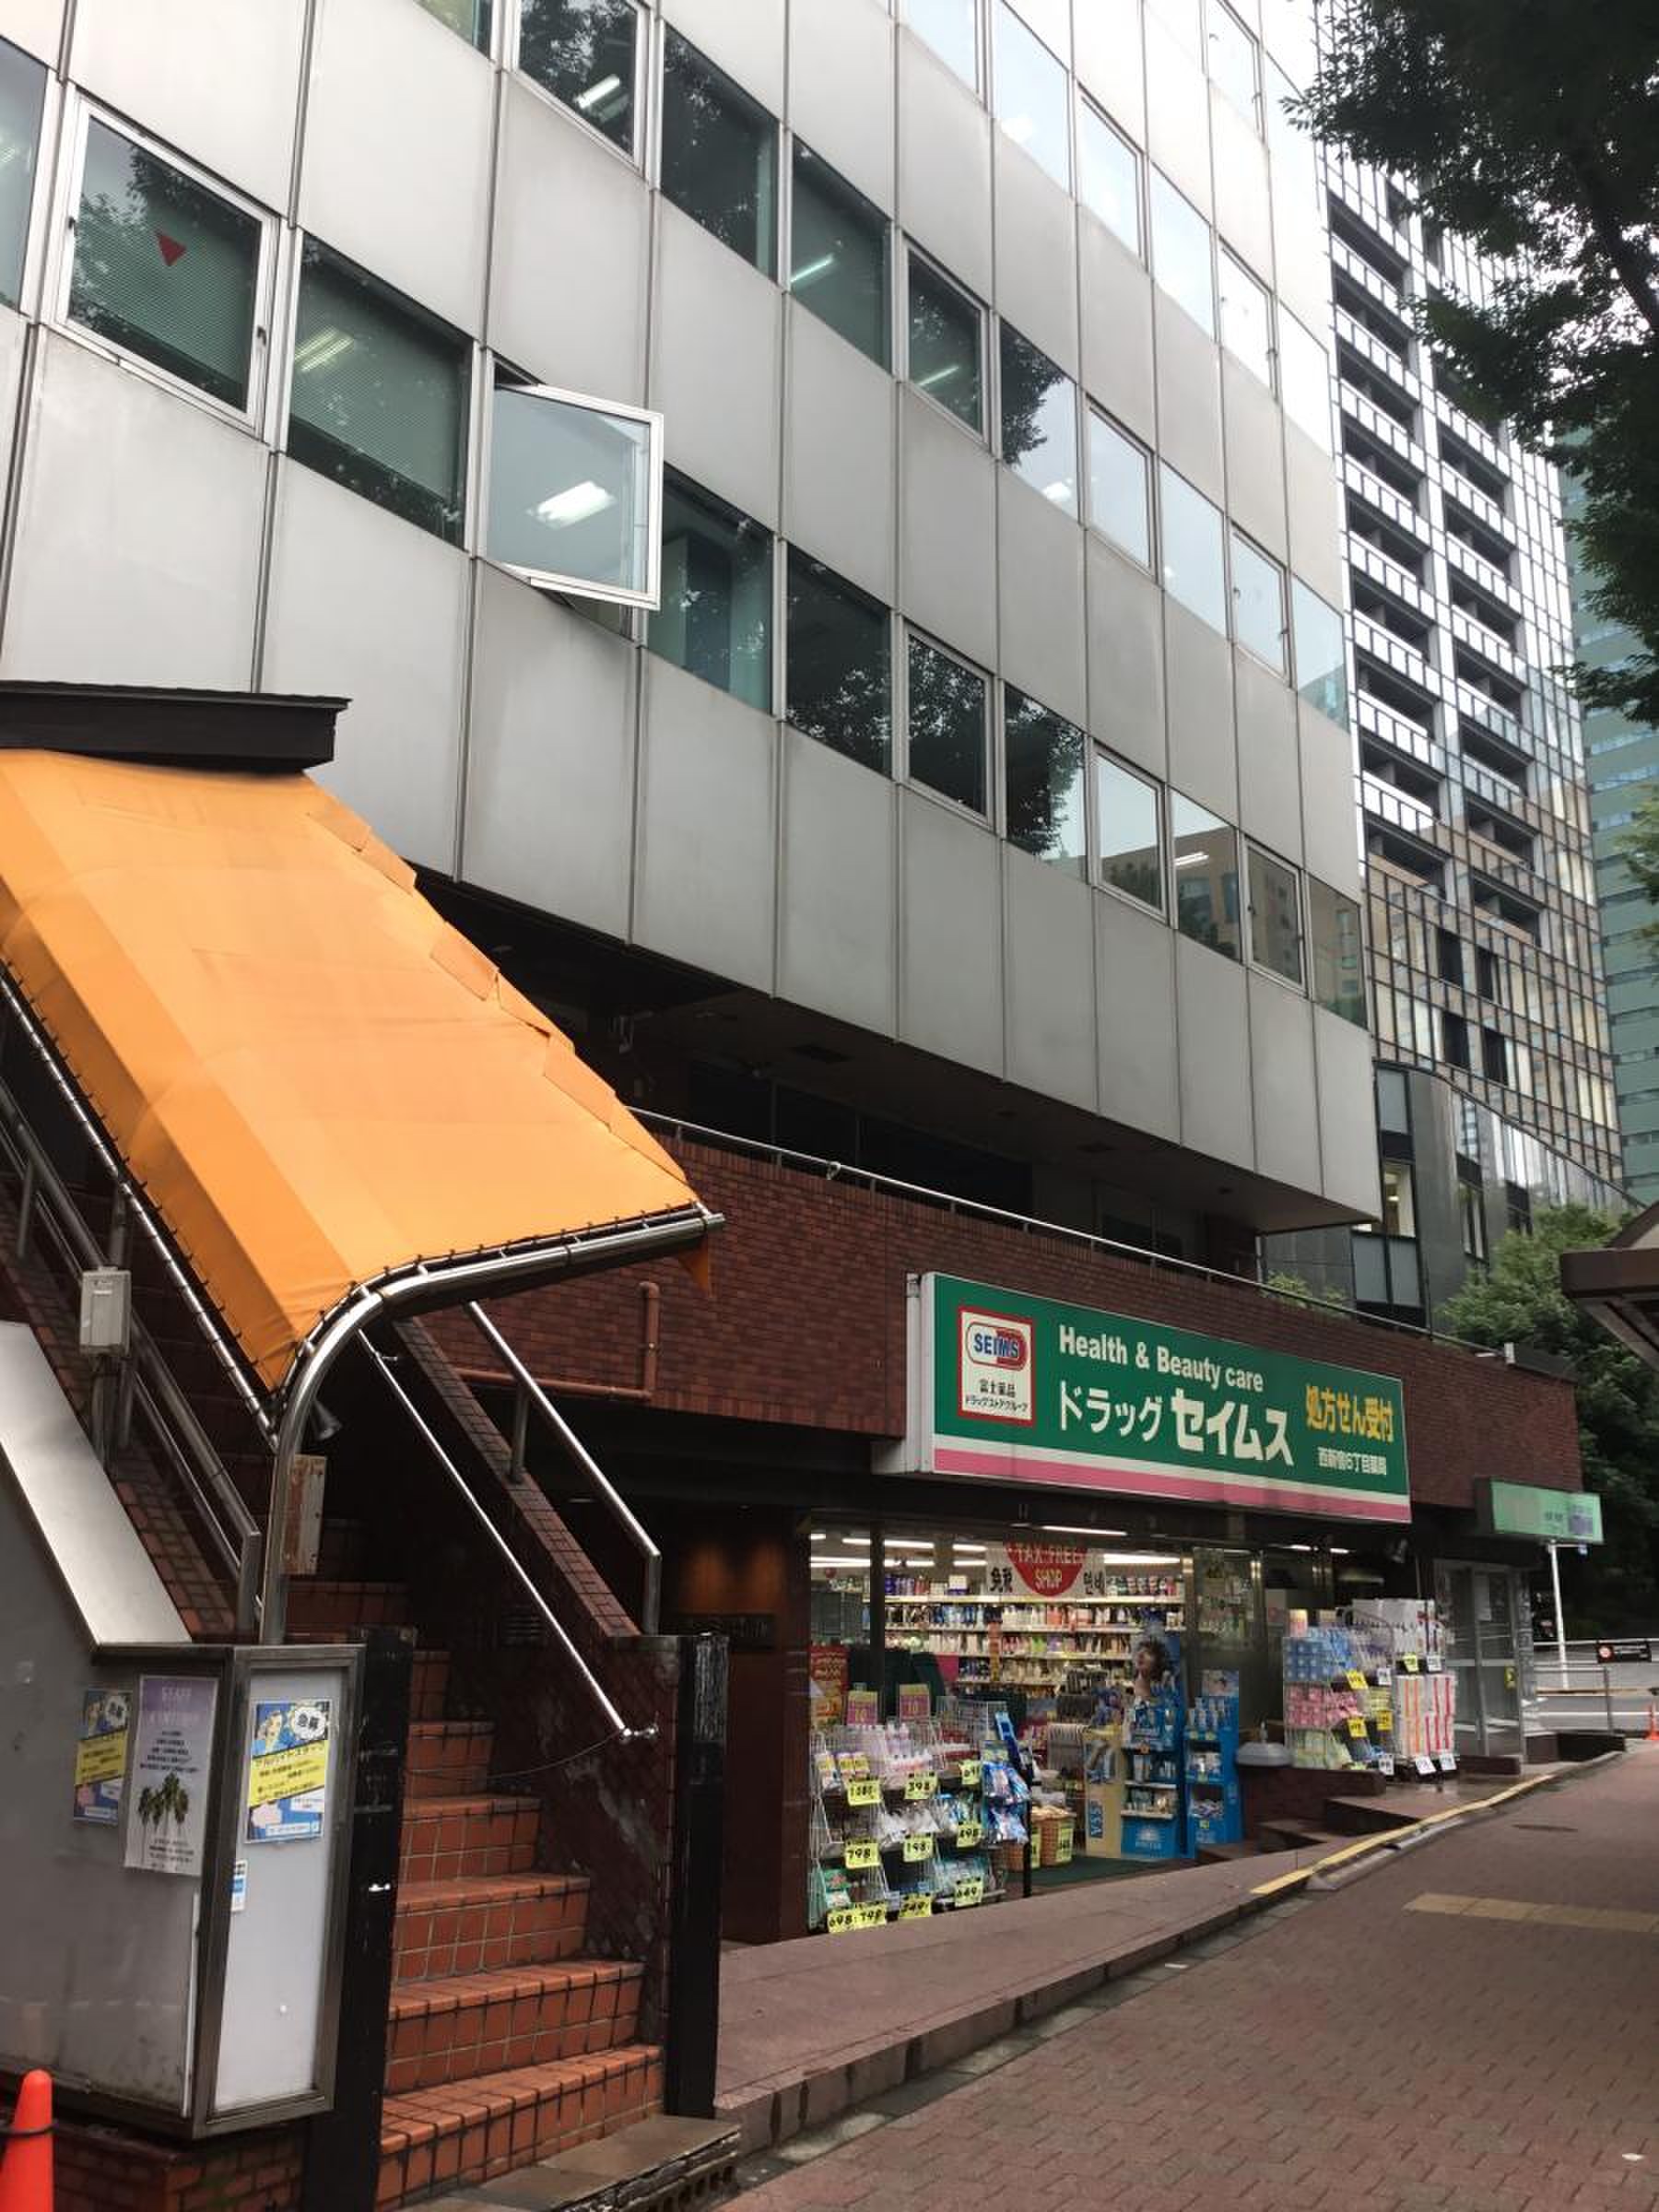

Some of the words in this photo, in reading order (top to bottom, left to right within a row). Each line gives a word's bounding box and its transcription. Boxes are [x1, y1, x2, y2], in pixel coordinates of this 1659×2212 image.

[973, 1333, 1019, 1359] SEIMS
[1059, 1324, 1129, 1366] Health
[1135, 1341, 1151, 1370] &
[1156, 1345, 1222, 1391] Beauty
[1224, 1365, 1265, 1393] care
[1060, 1380, 1163, 1442] ドラッグ
[1171, 1387, 1295, 1466] セイムス
[1305, 1382, 1394, 1443] 処方せん受付
